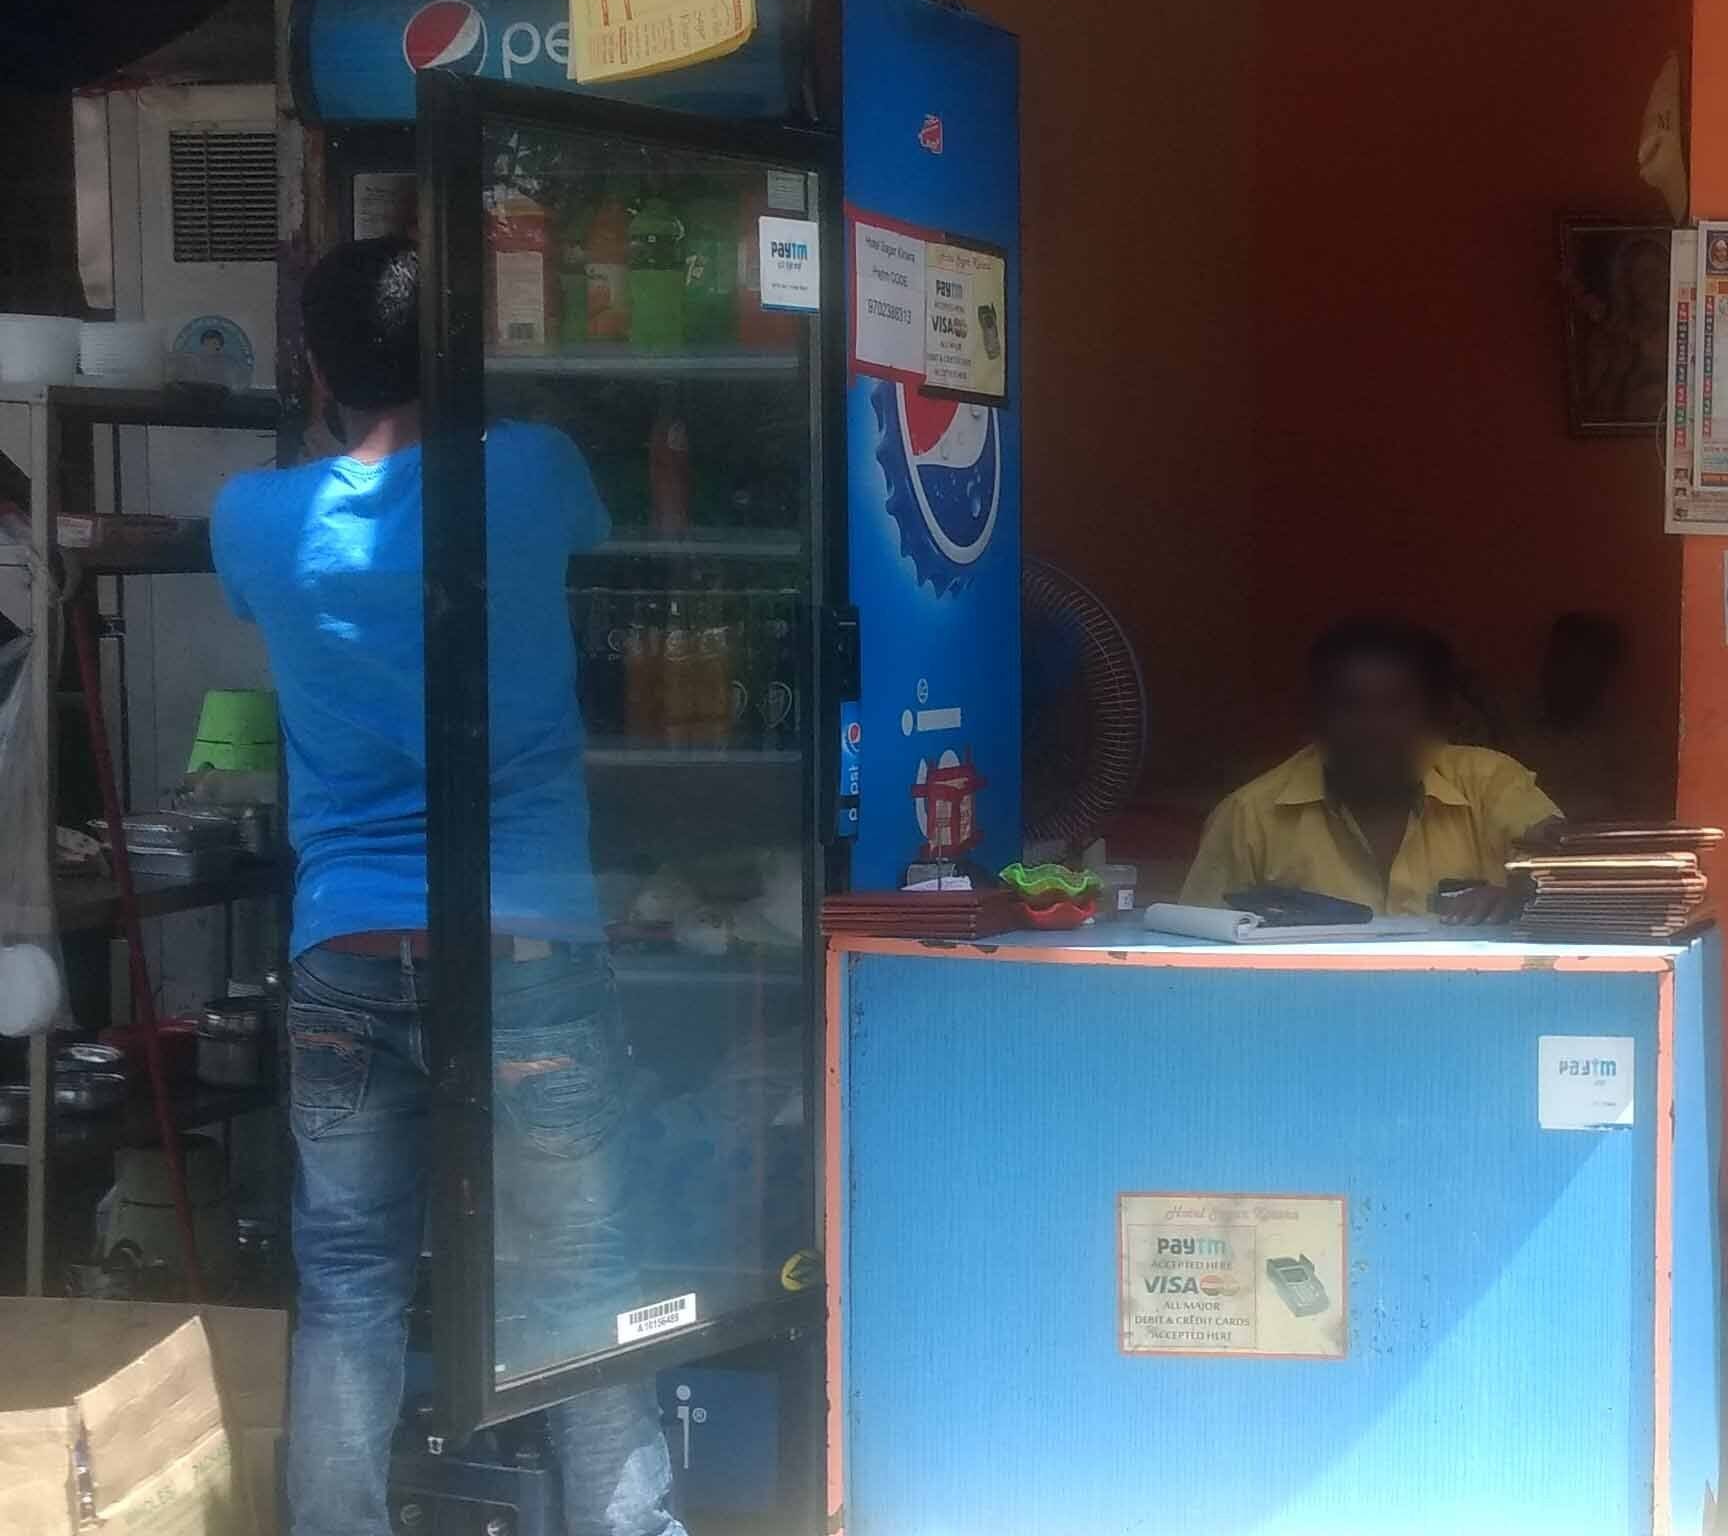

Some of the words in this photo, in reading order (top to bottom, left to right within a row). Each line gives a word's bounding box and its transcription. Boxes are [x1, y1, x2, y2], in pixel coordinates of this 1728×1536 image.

[1151, 1260, 1204, 1271] ACCEPTED
[1206, 1260, 1233, 1271] HERE
[1143, 1275, 1199, 1295] VISA
[1165, 1301, 1184, 1311] ALL
[1183, 1301, 1221, 1312] MAJOR
[1135, 1315, 1165, 1325] DEBIT
[1175, 1315, 1213, 1325] CREDIT
[1215, 1317, 1250, 1327] CARDS
[1151, 1330, 1204, 1341] ACCEPTED
[1206, 1331, 1233, 1342] HERE
